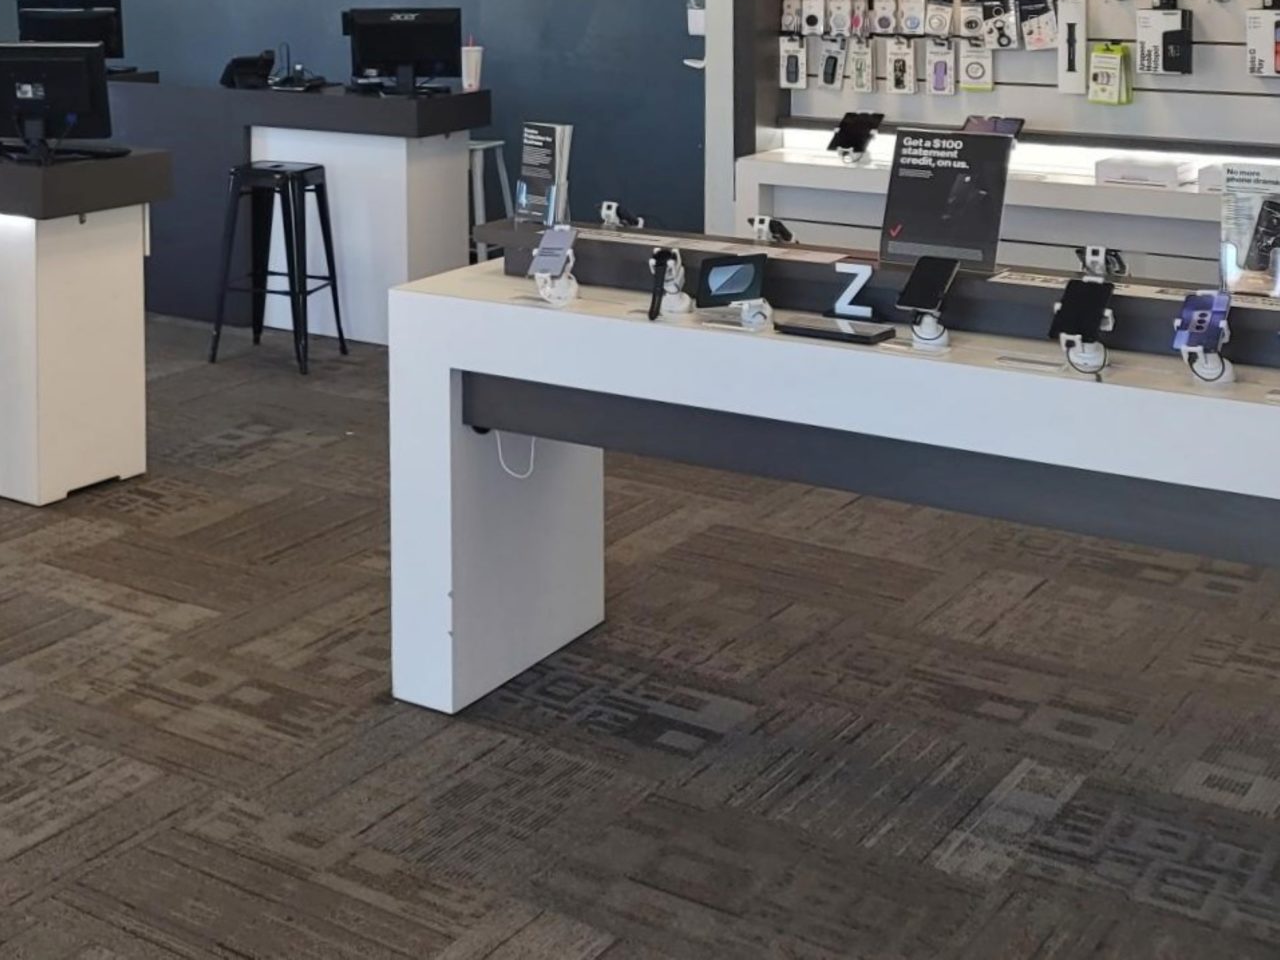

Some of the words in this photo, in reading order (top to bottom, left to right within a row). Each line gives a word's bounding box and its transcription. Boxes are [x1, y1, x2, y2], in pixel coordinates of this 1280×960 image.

[389, 13, 419, 21] acer
[902, 136, 924, 148] Get
[924, 139, 932, 148] a
[932, 138, 964, 150] $100
[901, 147, 959, 159] statement
[899, 156, 936, 168] credit,
[936, 159, 952, 168] on
[952, 160, 970, 169] us.
[834, 262, 873, 318] Z
